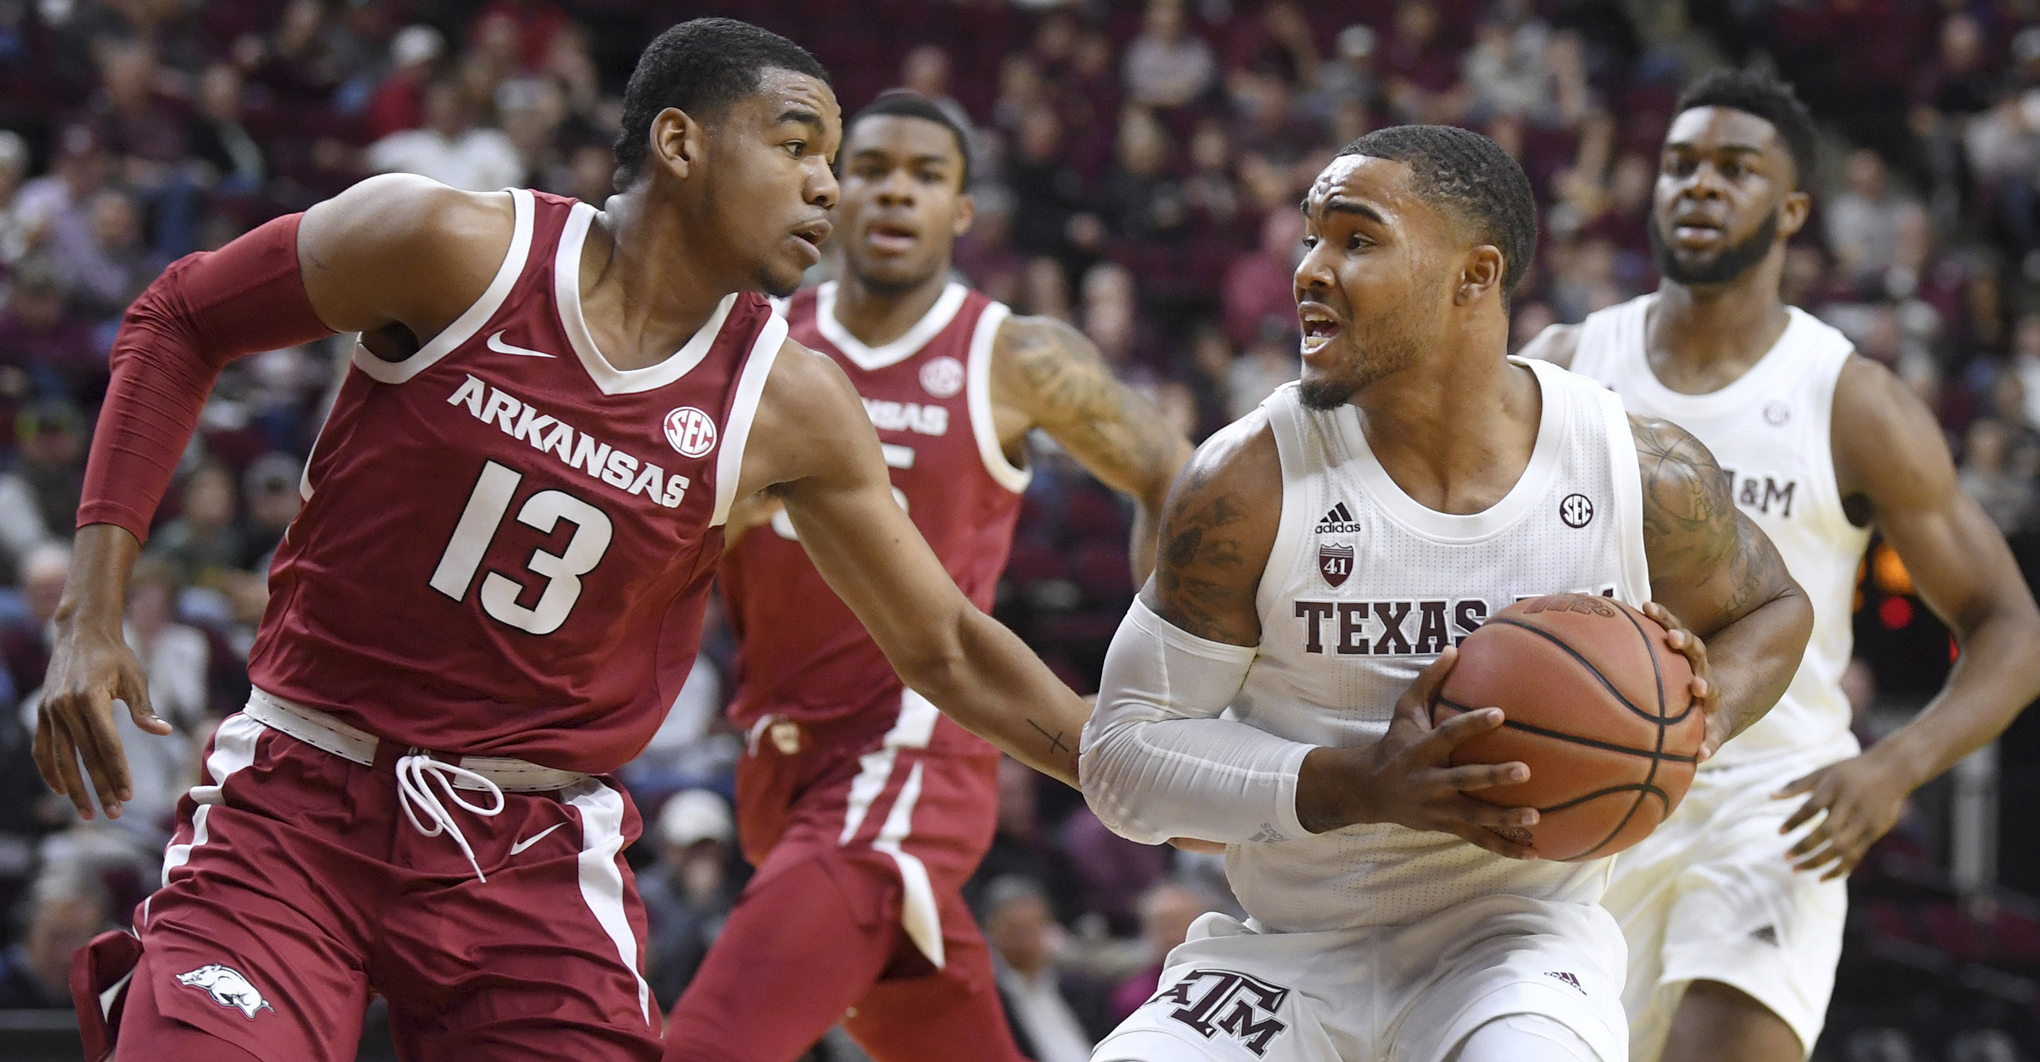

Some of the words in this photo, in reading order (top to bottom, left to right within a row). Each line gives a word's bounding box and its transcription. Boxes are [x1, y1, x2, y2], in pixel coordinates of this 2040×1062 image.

[447, 374, 690, 508] ARKANSAS
[667, 408, 715, 455] SEC
[1314, 521, 1361, 534] adidas
[1561, 495, 1592, 527] SEC
[428, 458, 614, 635] 13
[1323, 557, 1347, 576] 41
[1294, 598, 1488, 656] TEXAS
